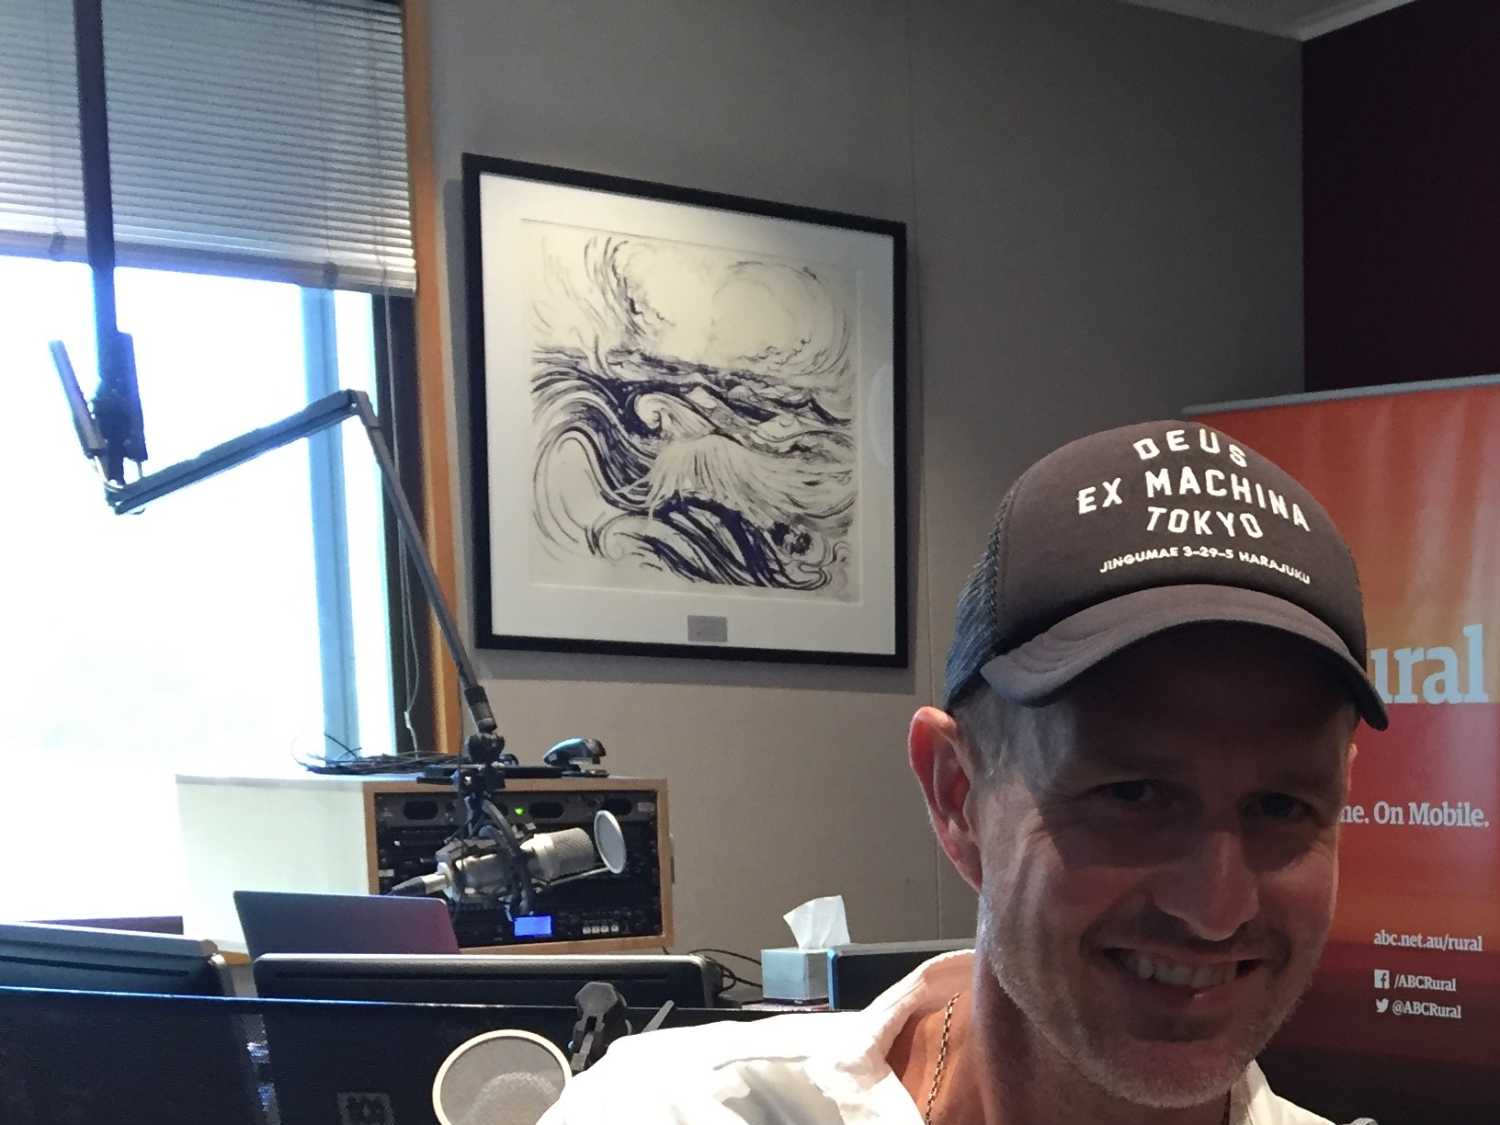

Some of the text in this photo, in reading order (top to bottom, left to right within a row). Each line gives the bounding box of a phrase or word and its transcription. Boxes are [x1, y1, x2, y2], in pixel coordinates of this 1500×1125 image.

[1133, 428, 1247, 468] DEUS
[1077, 466, 1311, 532] EX MACHINA
[1146, 506, 1263, 538] TOKYO
[1100, 546, 1311, 585] JINGUMAE 3-29-5 HARAJUKU
[1374, 801, 1403, 824] On
[1408, 801, 1490, 828] Mobile.
[1374, 929, 1483, 951] abc.net.au/rural
[1394, 974, 1457, 992] /ABCRural
[1392, 1000, 1462, 1019] @ABCRural
